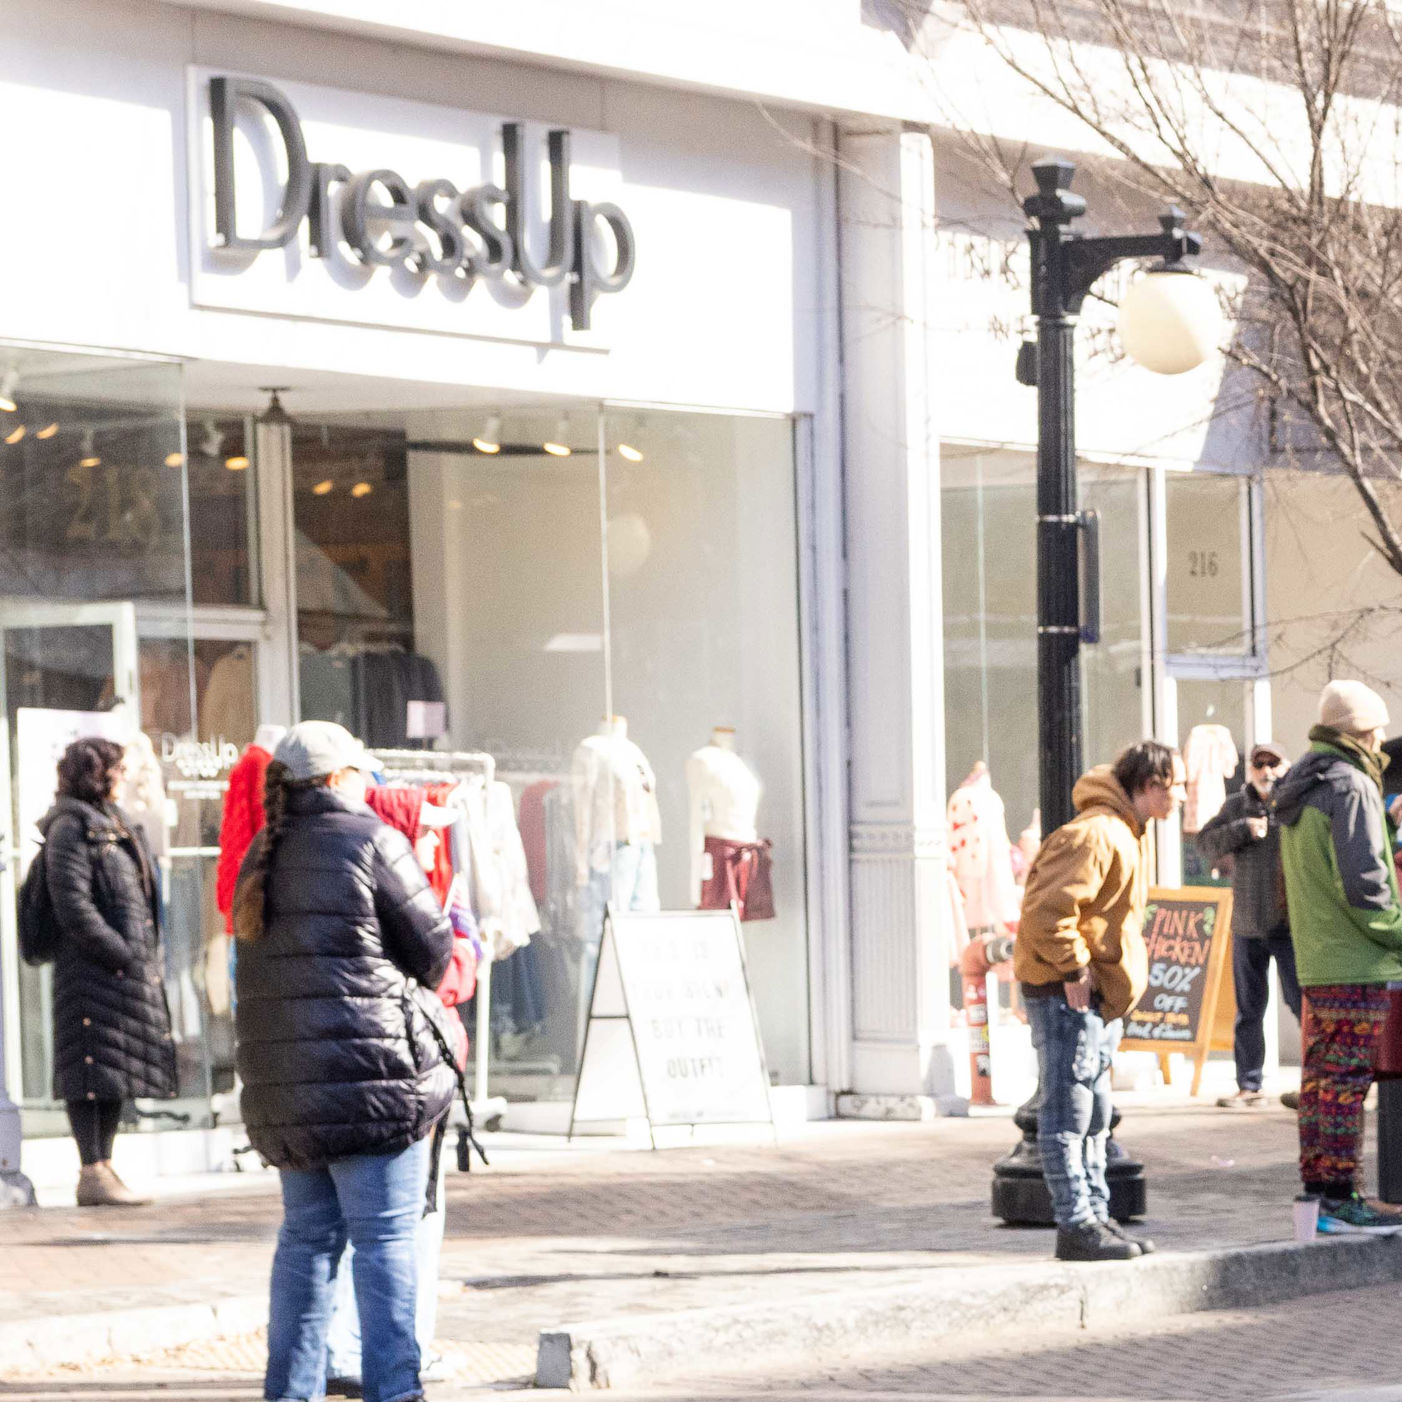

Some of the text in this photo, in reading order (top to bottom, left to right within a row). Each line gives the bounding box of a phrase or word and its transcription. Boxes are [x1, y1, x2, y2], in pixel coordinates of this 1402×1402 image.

[208, 76, 636, 331] DressUp
[1188, 550, 1219, 578] 216
[1151, 907, 1204, 939] PINK
[1142, 934, 1212, 967] HICKEN
[1148, 962, 1202, 994] 50%
[1153, 993, 1190, 1013] OFF
